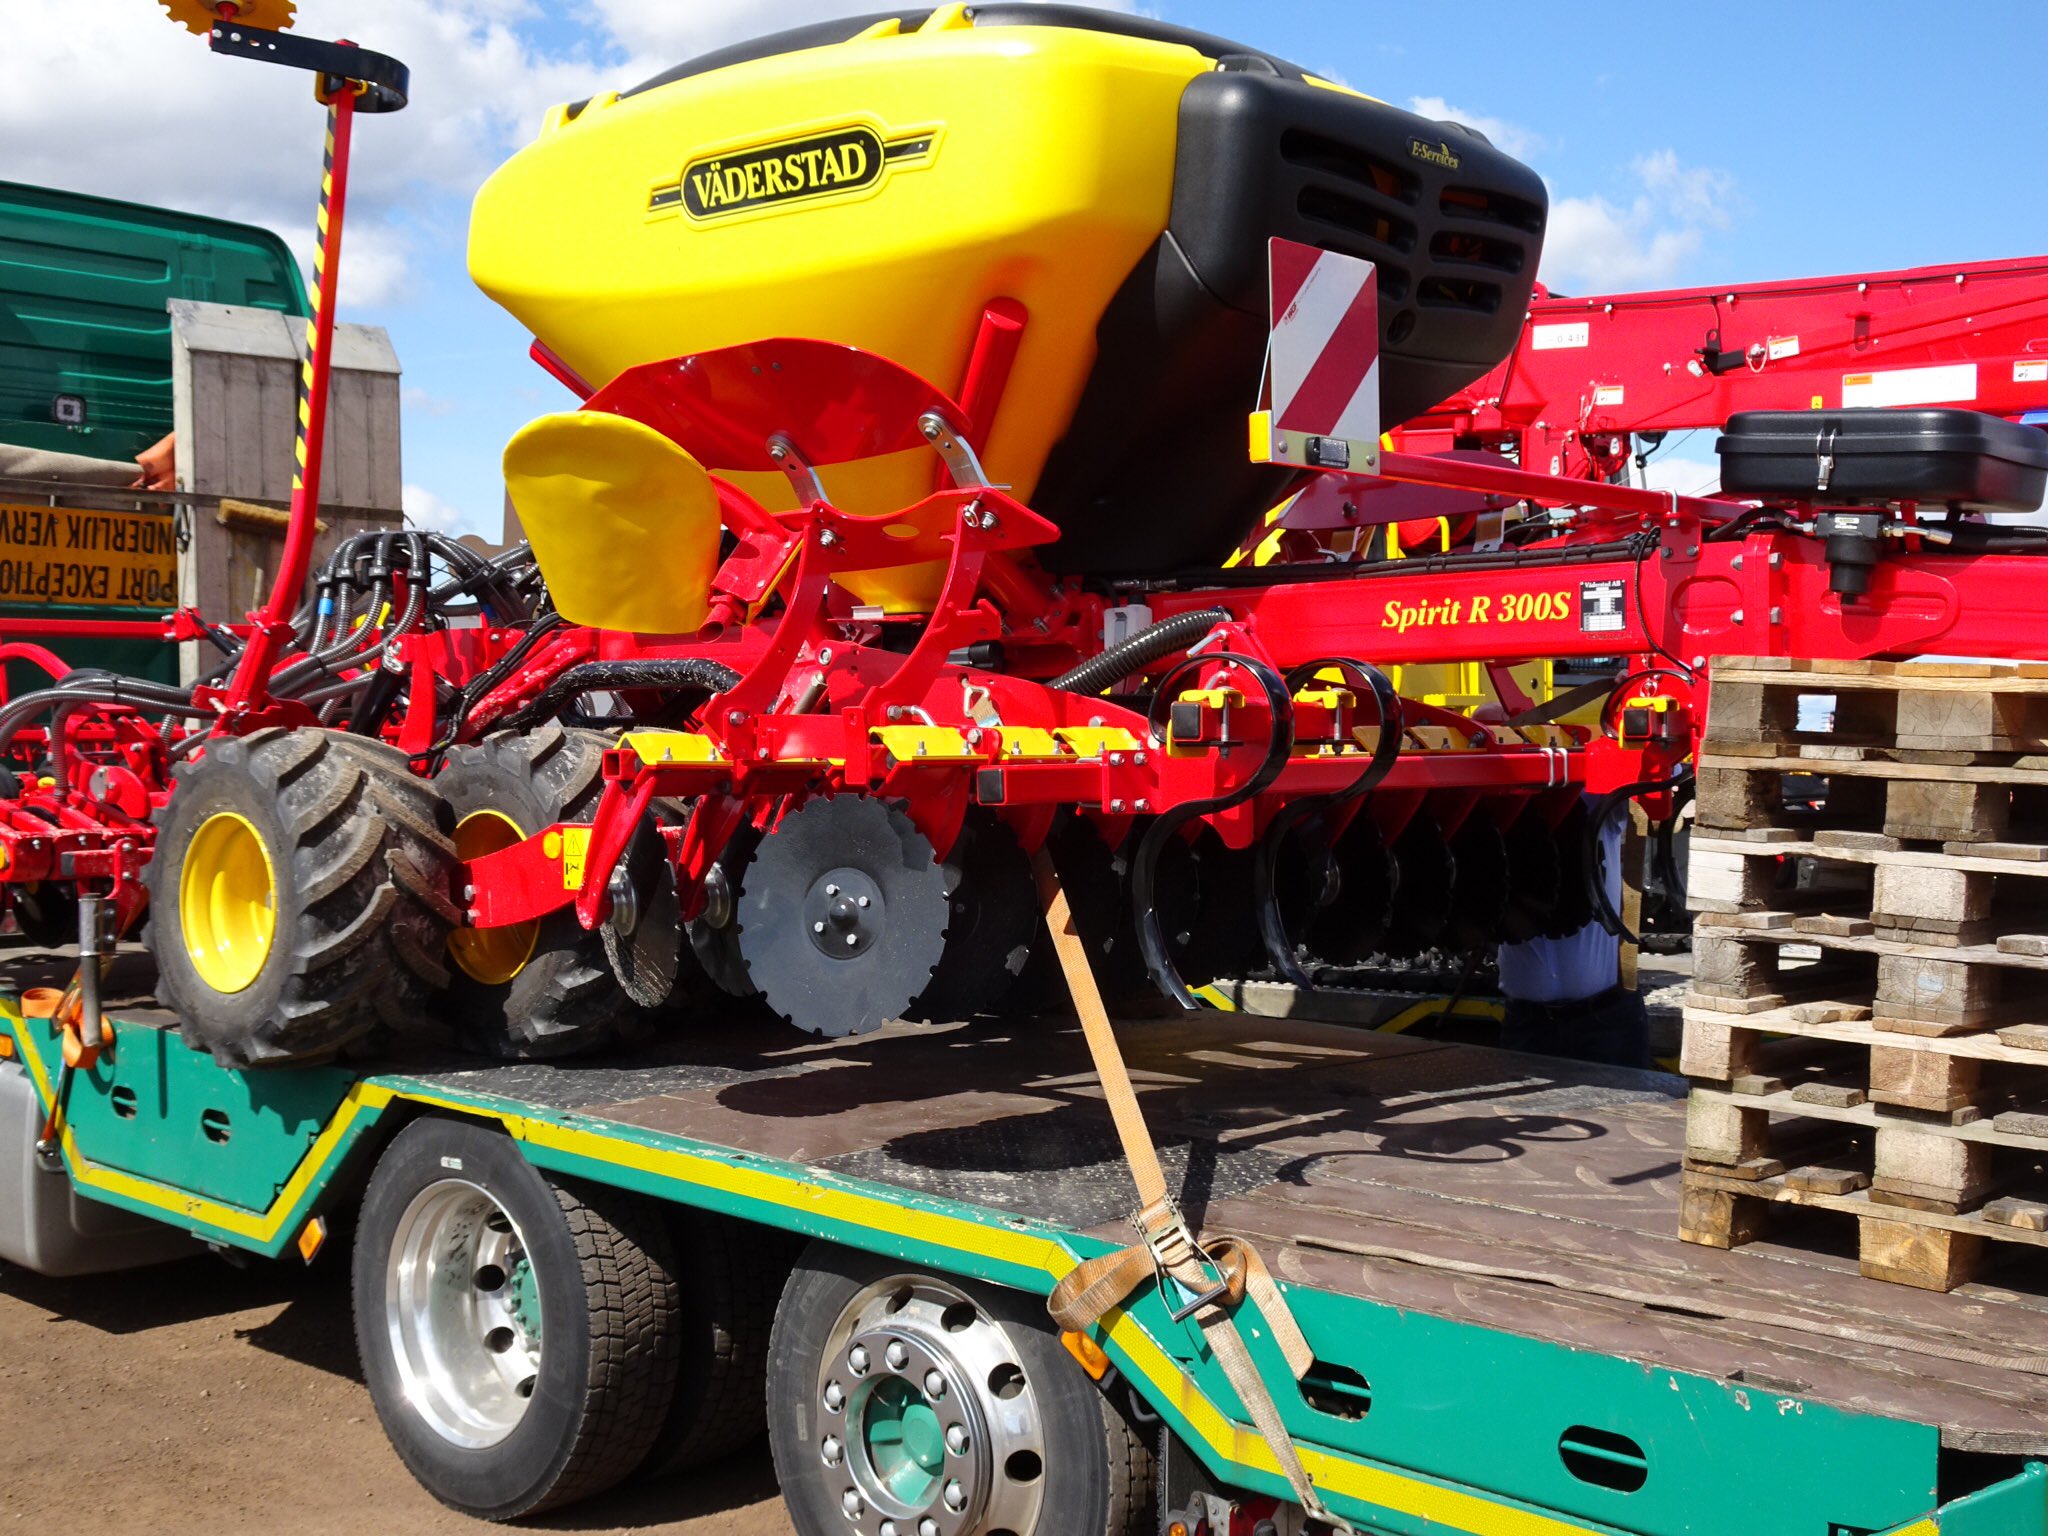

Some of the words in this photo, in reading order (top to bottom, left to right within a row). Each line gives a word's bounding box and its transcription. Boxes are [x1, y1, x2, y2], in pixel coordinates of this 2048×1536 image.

[692, 142, 867, 209] VÄDERSTAD
[66, 514, 177, 555] NDERLIJK
[117, 567, 178, 603] PORT
[1381, 597, 1461, 634] Spirit
[1467, 596, 1491, 624] R
[1497, 591, 1572, 623] 300S
